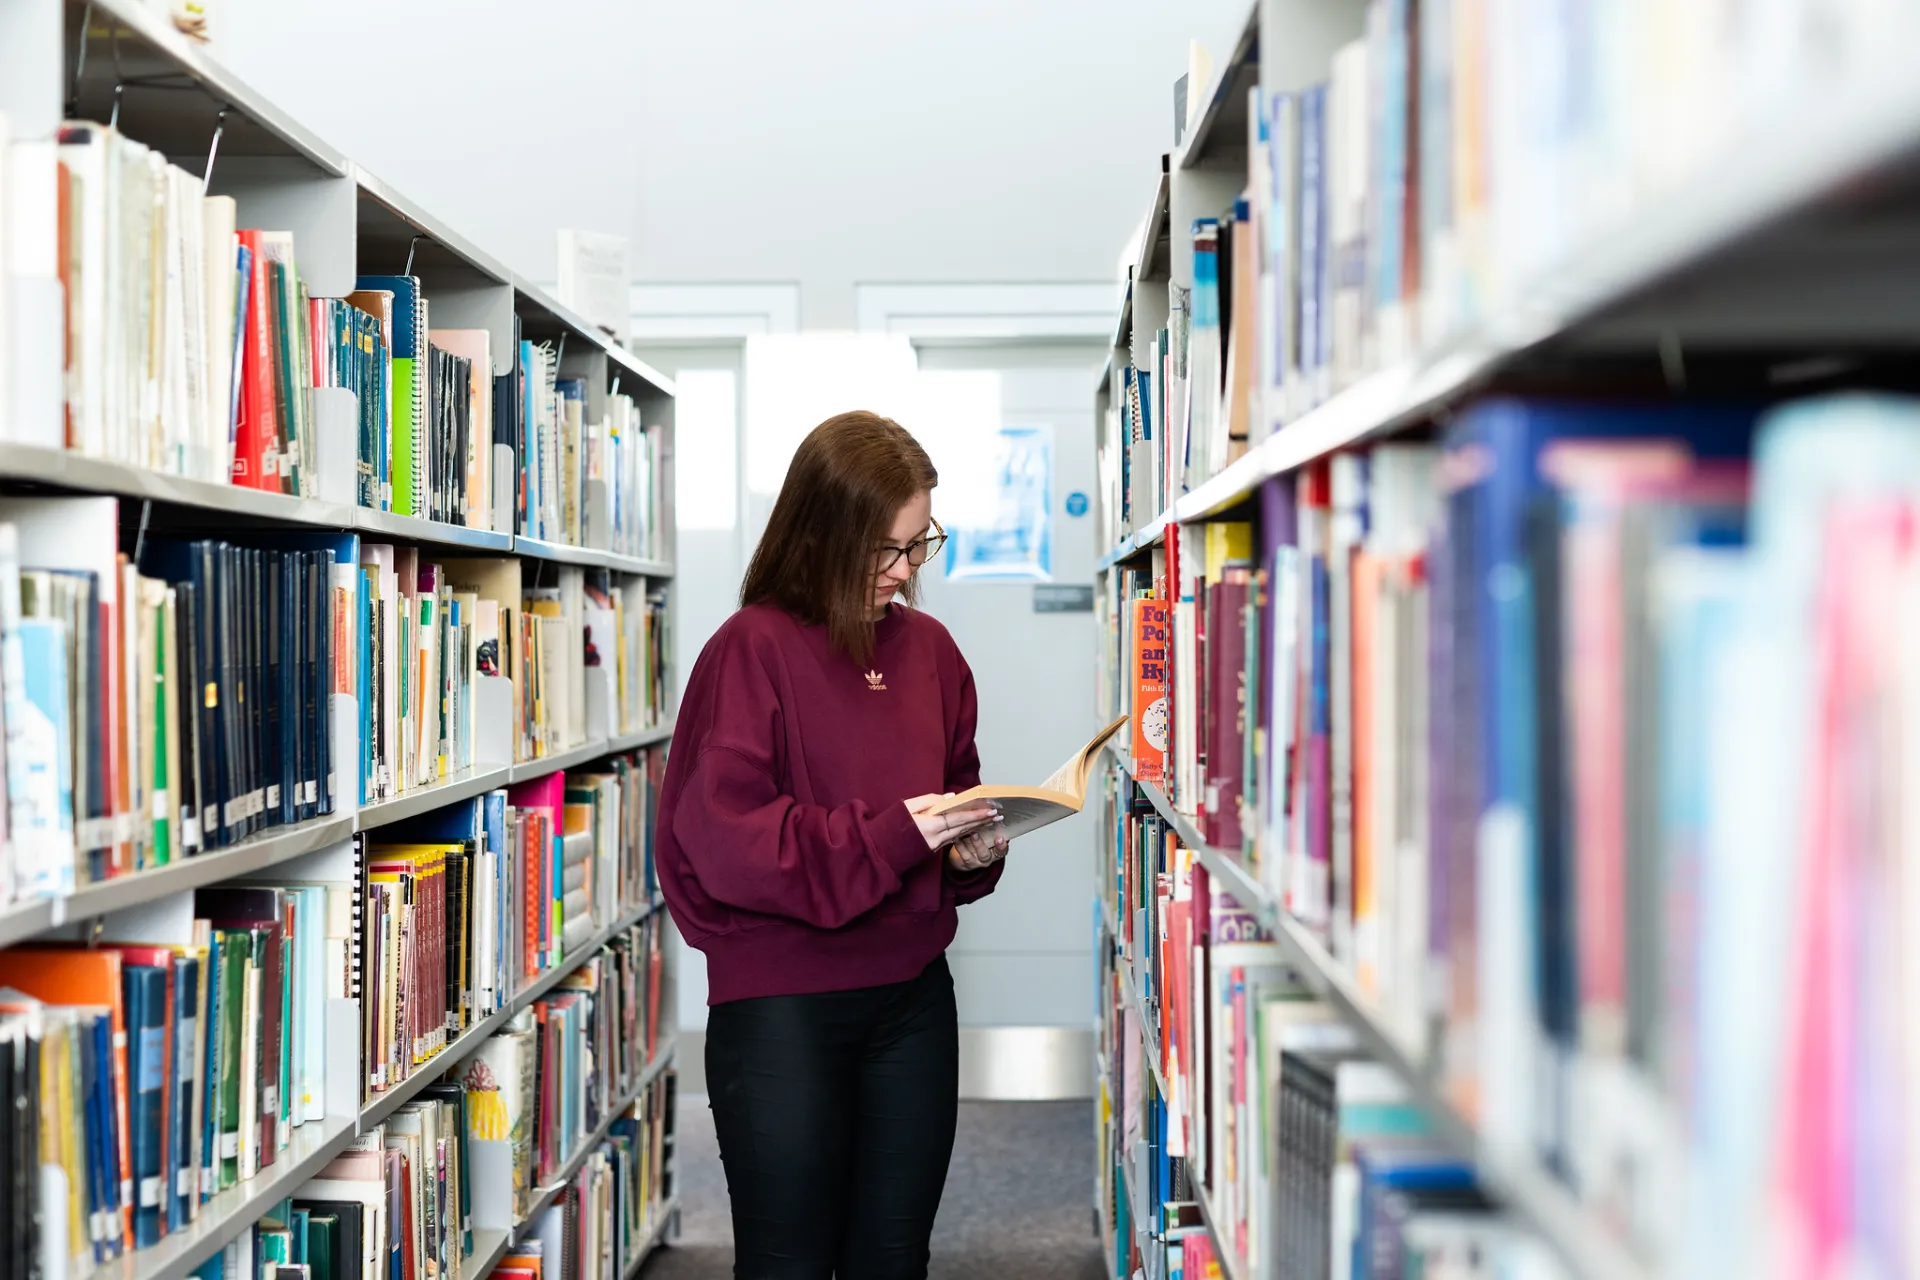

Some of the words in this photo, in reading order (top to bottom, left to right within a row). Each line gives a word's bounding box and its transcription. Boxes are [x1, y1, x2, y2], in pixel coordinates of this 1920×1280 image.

[1142, 606, 1164, 622] Fo
[1142, 625, 1164, 641] Po
[1142, 648, 1164, 661] an
[1141, 663, 1164, 683] Hy
